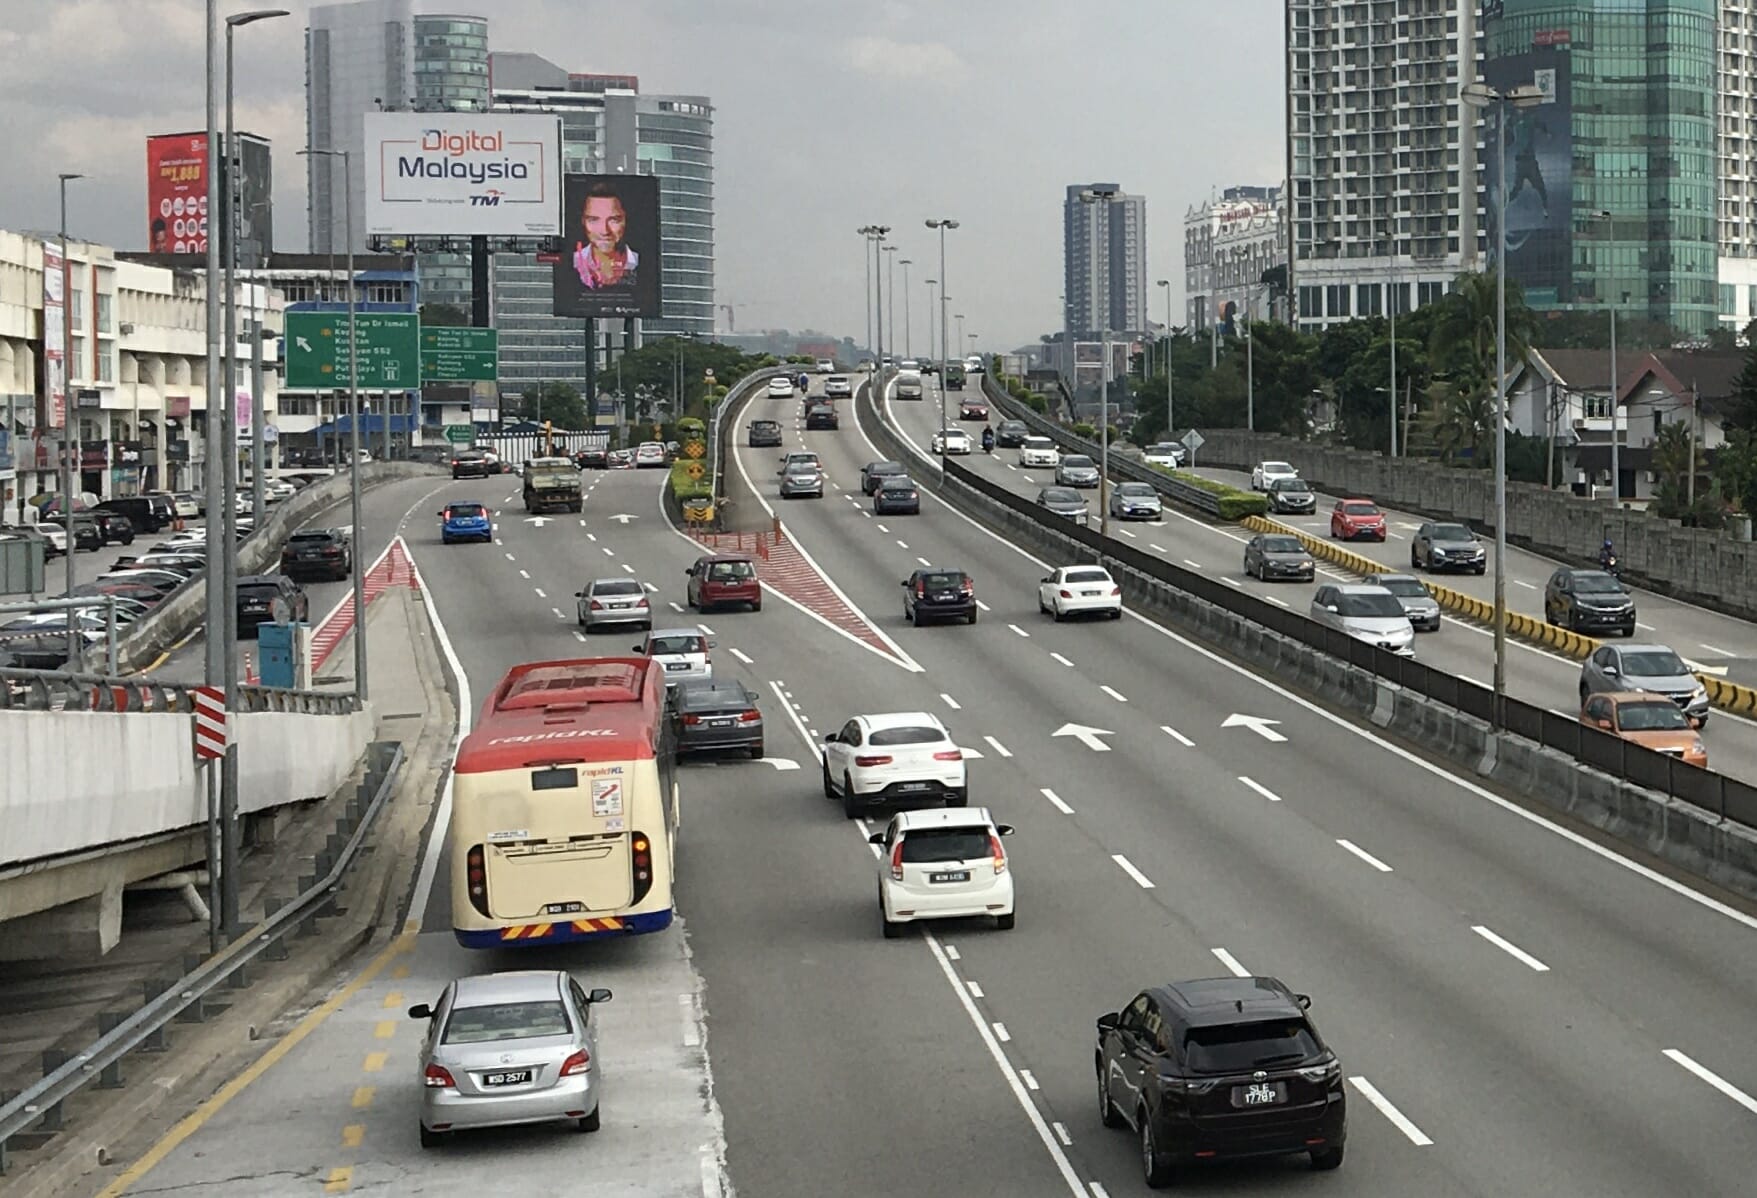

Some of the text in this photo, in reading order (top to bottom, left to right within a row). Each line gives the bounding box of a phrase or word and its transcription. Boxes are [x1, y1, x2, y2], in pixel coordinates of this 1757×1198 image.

[421, 129, 503, 157] Digital
[398, 156, 528, 184] Malaysia
[469, 195, 500, 207] TM
[488, 729, 619, 745] rapidKL
